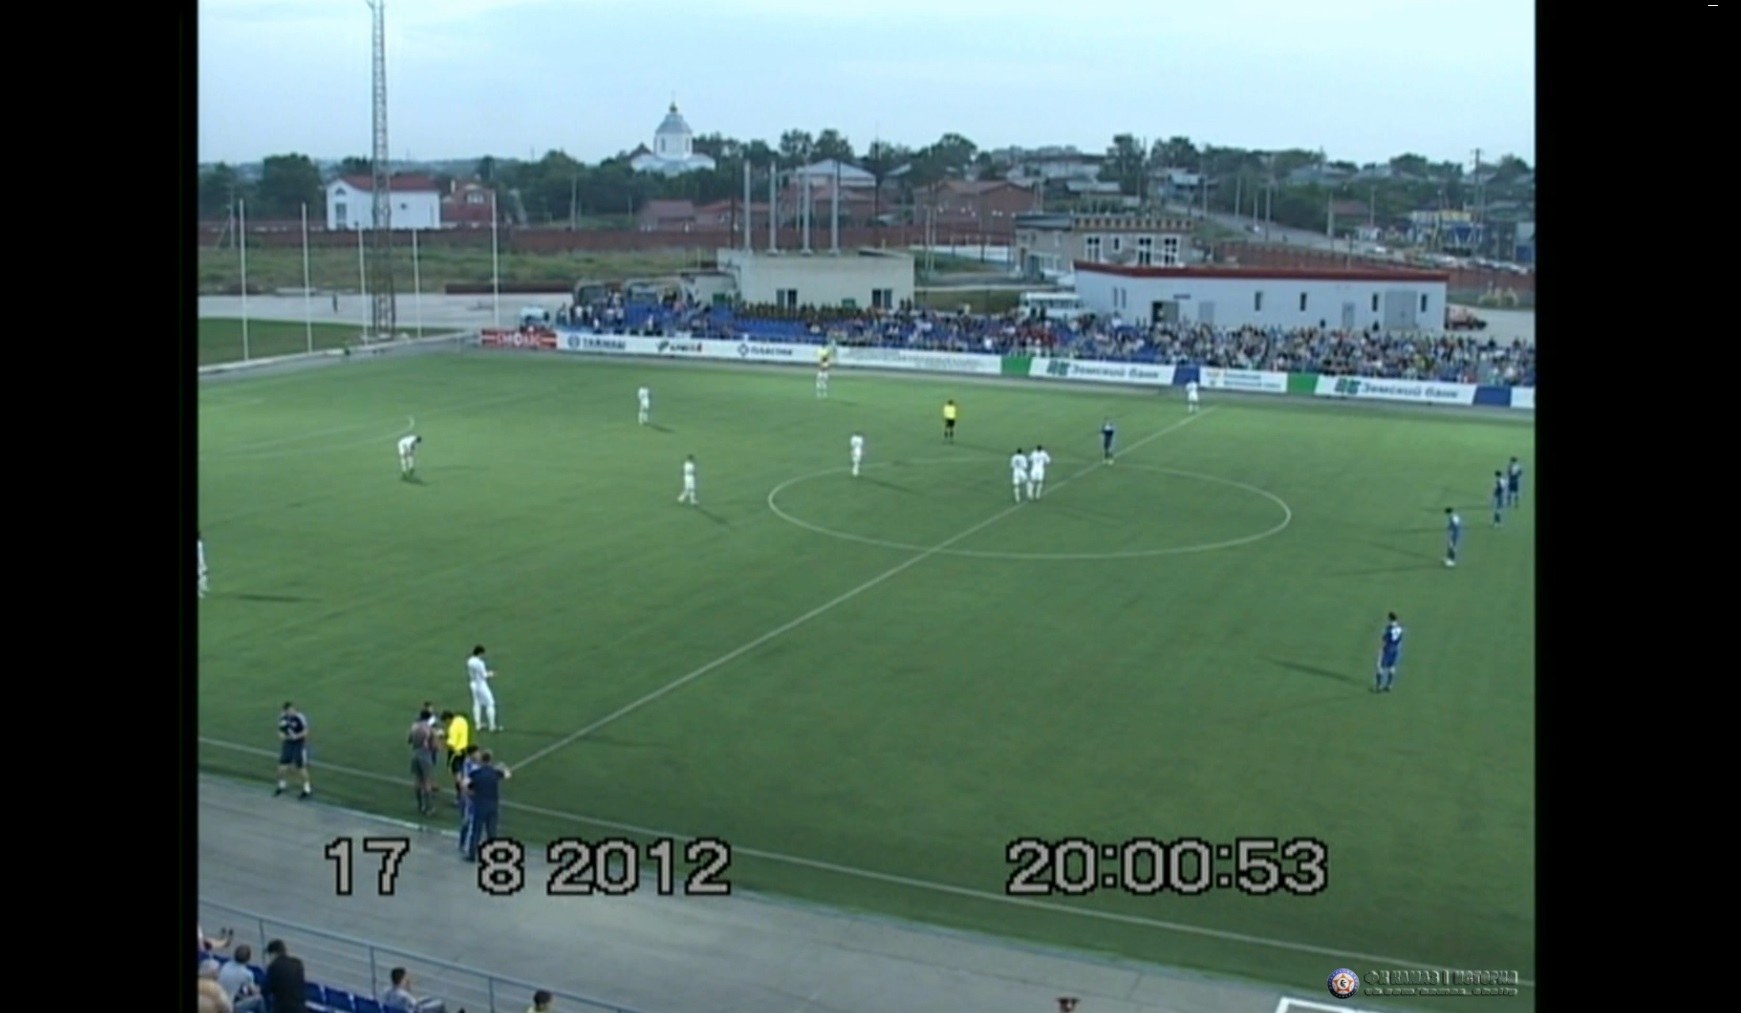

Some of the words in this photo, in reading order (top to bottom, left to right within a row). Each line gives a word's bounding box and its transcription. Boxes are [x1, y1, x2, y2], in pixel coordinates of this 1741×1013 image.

[1072, 365, 1125, 378] Земский
[1128, 367, 1159, 379] банк
[1360, 383, 1421, 396] Земский
[1425, 385, 1458, 398] банк
